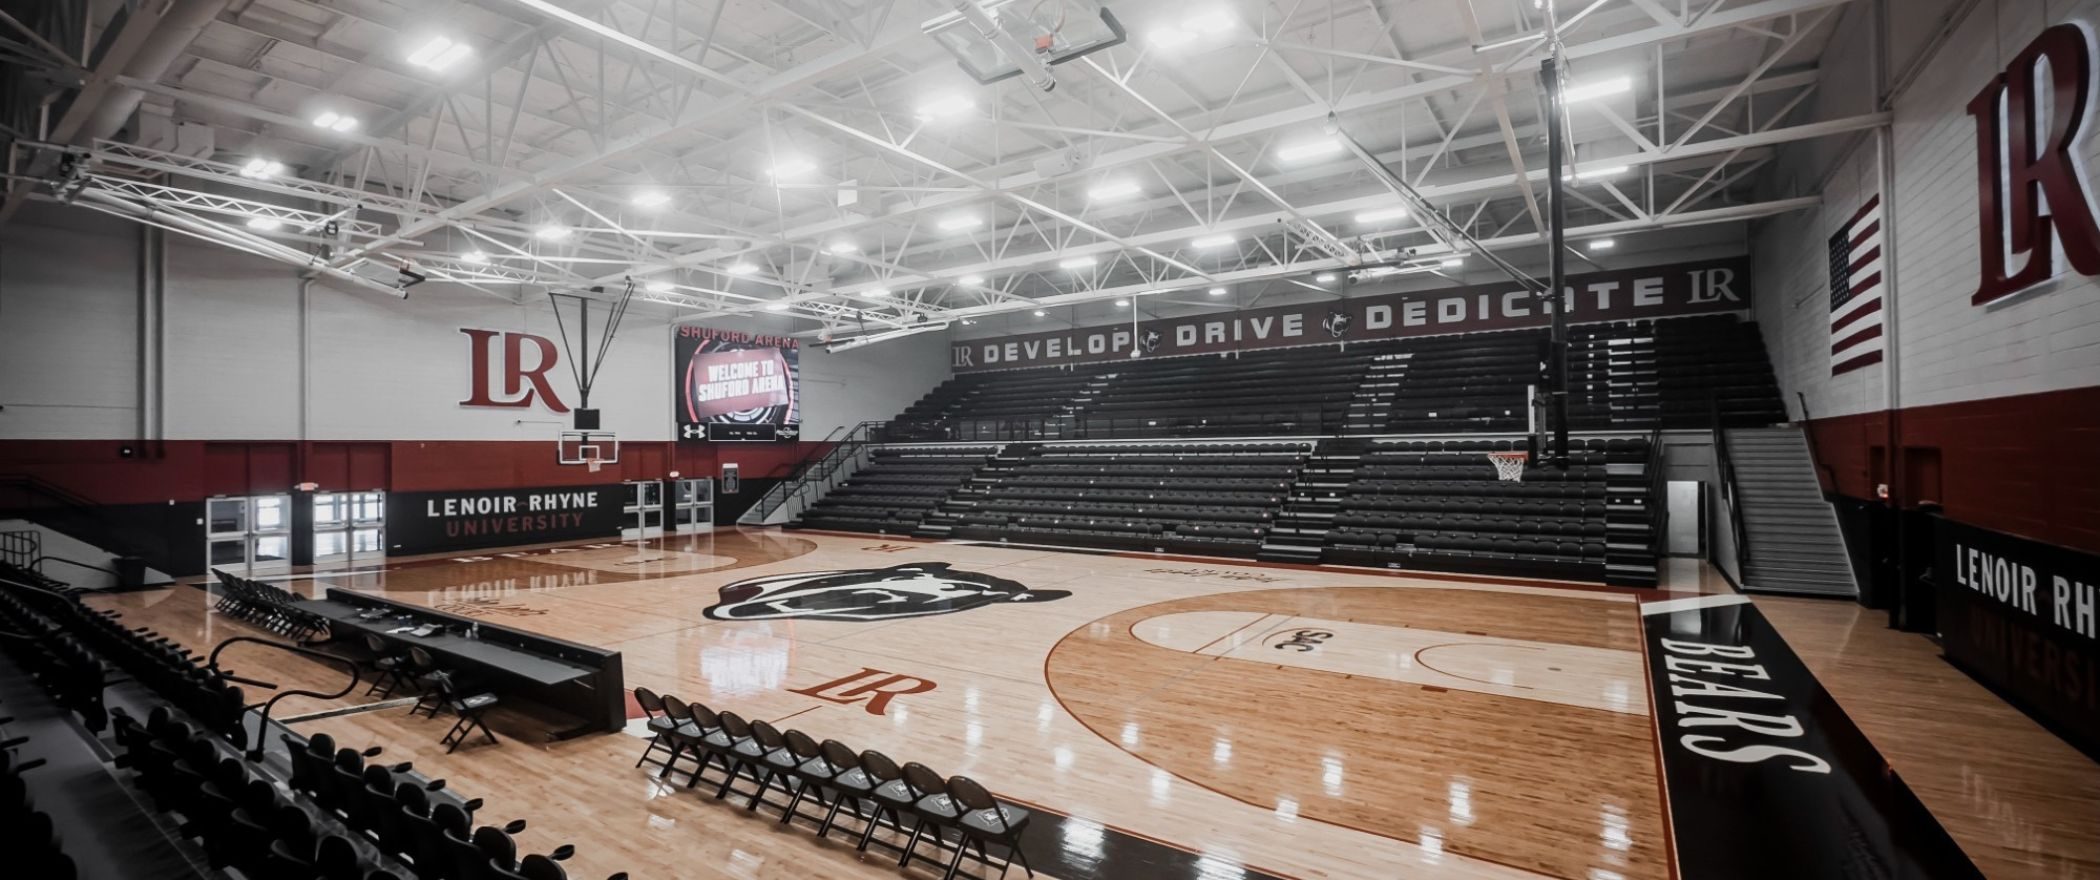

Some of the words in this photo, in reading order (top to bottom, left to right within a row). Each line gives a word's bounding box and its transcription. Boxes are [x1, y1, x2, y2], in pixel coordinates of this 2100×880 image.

[1966, 22, 2100, 306] LR
[680, 325, 749, 344] SHUFORD
[755, 334, 799, 350] ARENA
[984, 331, 1130, 363] DEVELOP
[1177, 313, 1303, 347] DRIVE
[1686, 267, 1741, 304] LR
[459, 328, 570, 413] LR
[698, 378, 750, 402] SHUFORD
[752, 375, 786, 395] ARENA
[708, 361, 759, 382] WELCOME
[760, 360, 774, 377] TO
[446, 512, 584, 537] UNIVERSITY
[1957, 543, 2037, 616] LENOIR
[2053, 574, 2100, 640] RH
[784, 667, 938, 716] LR
[1661, 638, 1831, 774] BEARS
